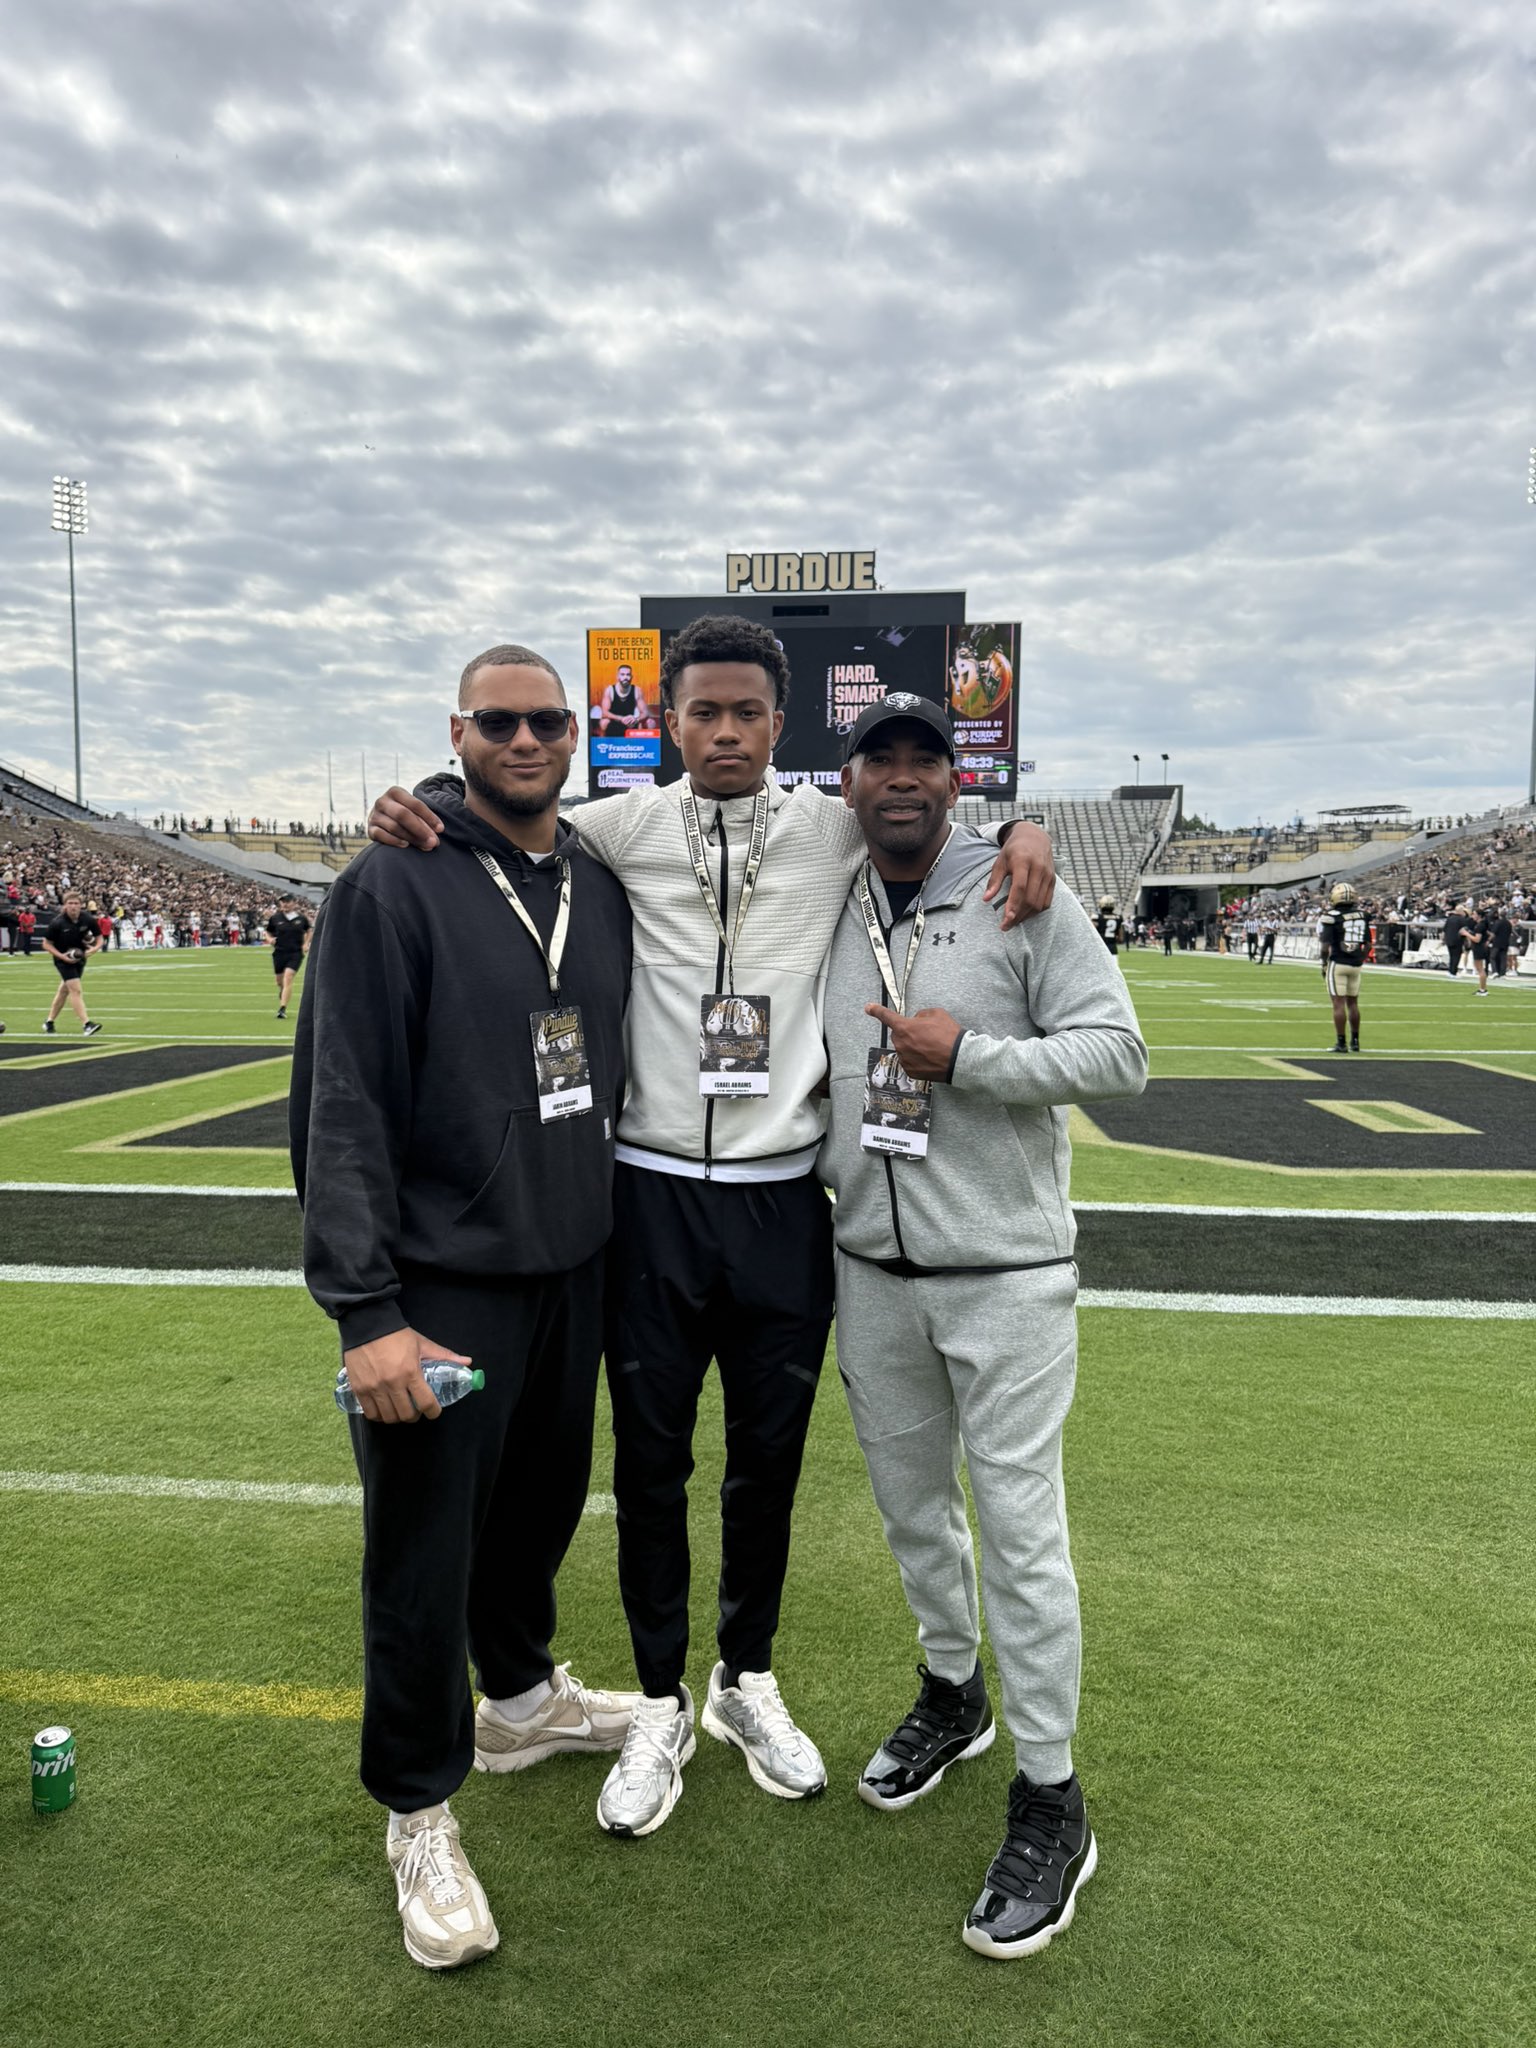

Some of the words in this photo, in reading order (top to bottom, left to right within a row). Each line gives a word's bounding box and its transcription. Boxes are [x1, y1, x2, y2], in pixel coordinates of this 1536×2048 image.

[727, 551, 875, 593] PURDUE
[596, 637, 615, 647] FROM
[617, 637, 629, 647] THE
[631, 637, 654, 647] BENCH
[597, 648, 609, 660] TO
[613, 648, 654, 660] BETTER!
[834, 665, 879, 683] HARD.
[834, 685, 888, 703] SMART
[683, 796, 698, 833] FOOTBALL
[755, 795, 767, 830] FOOTBALL
[690, 833, 703, 865] PURDUE
[751, 830, 764, 862] PURDUE
[862, 897, 877, 928] PURDUE
[1104, 919, 1117, 938] 2
[32, 1747, 76, 1777] prit
